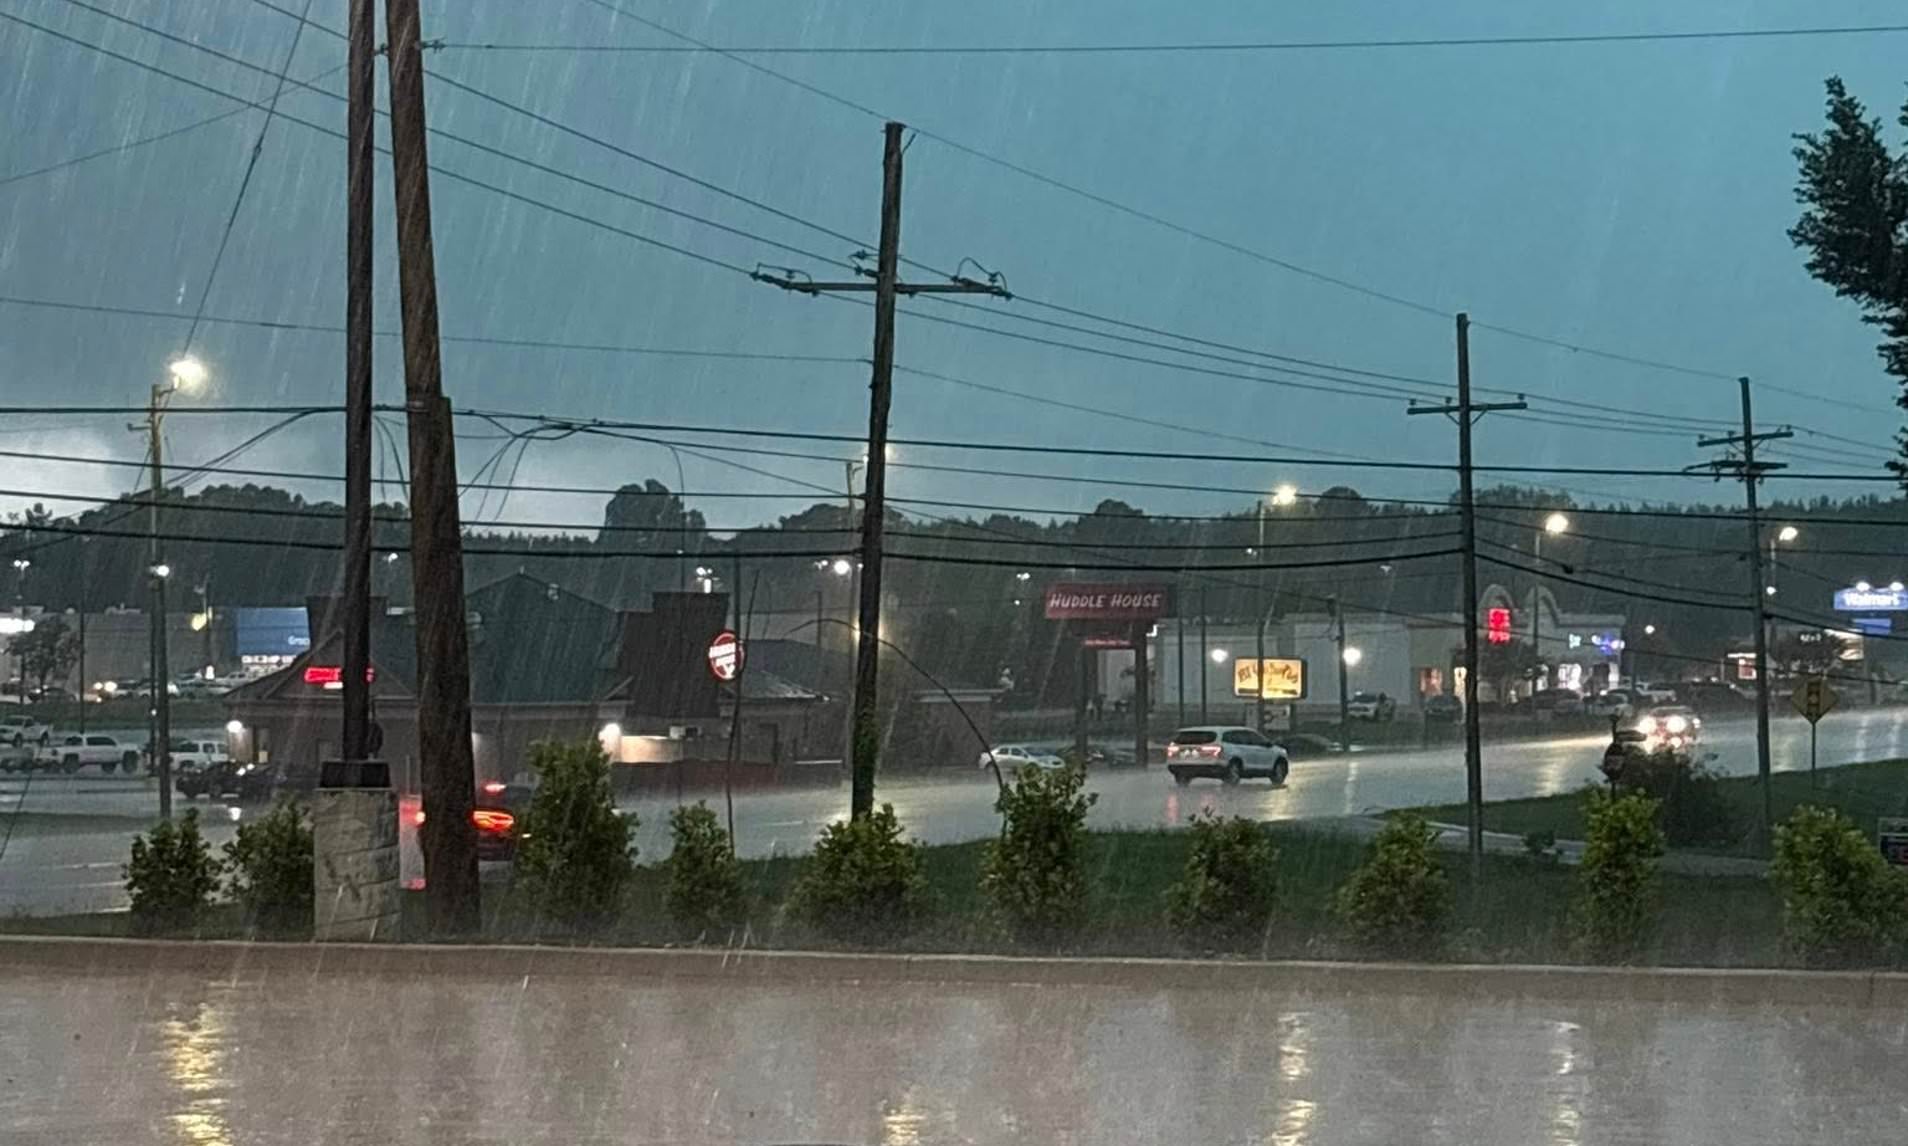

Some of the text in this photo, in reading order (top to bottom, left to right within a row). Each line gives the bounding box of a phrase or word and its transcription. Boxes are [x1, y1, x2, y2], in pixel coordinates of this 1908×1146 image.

[1050, 594, 1161, 608] HUDDLE HOUSE
[1843, 592, 1901, 607] Walmart
